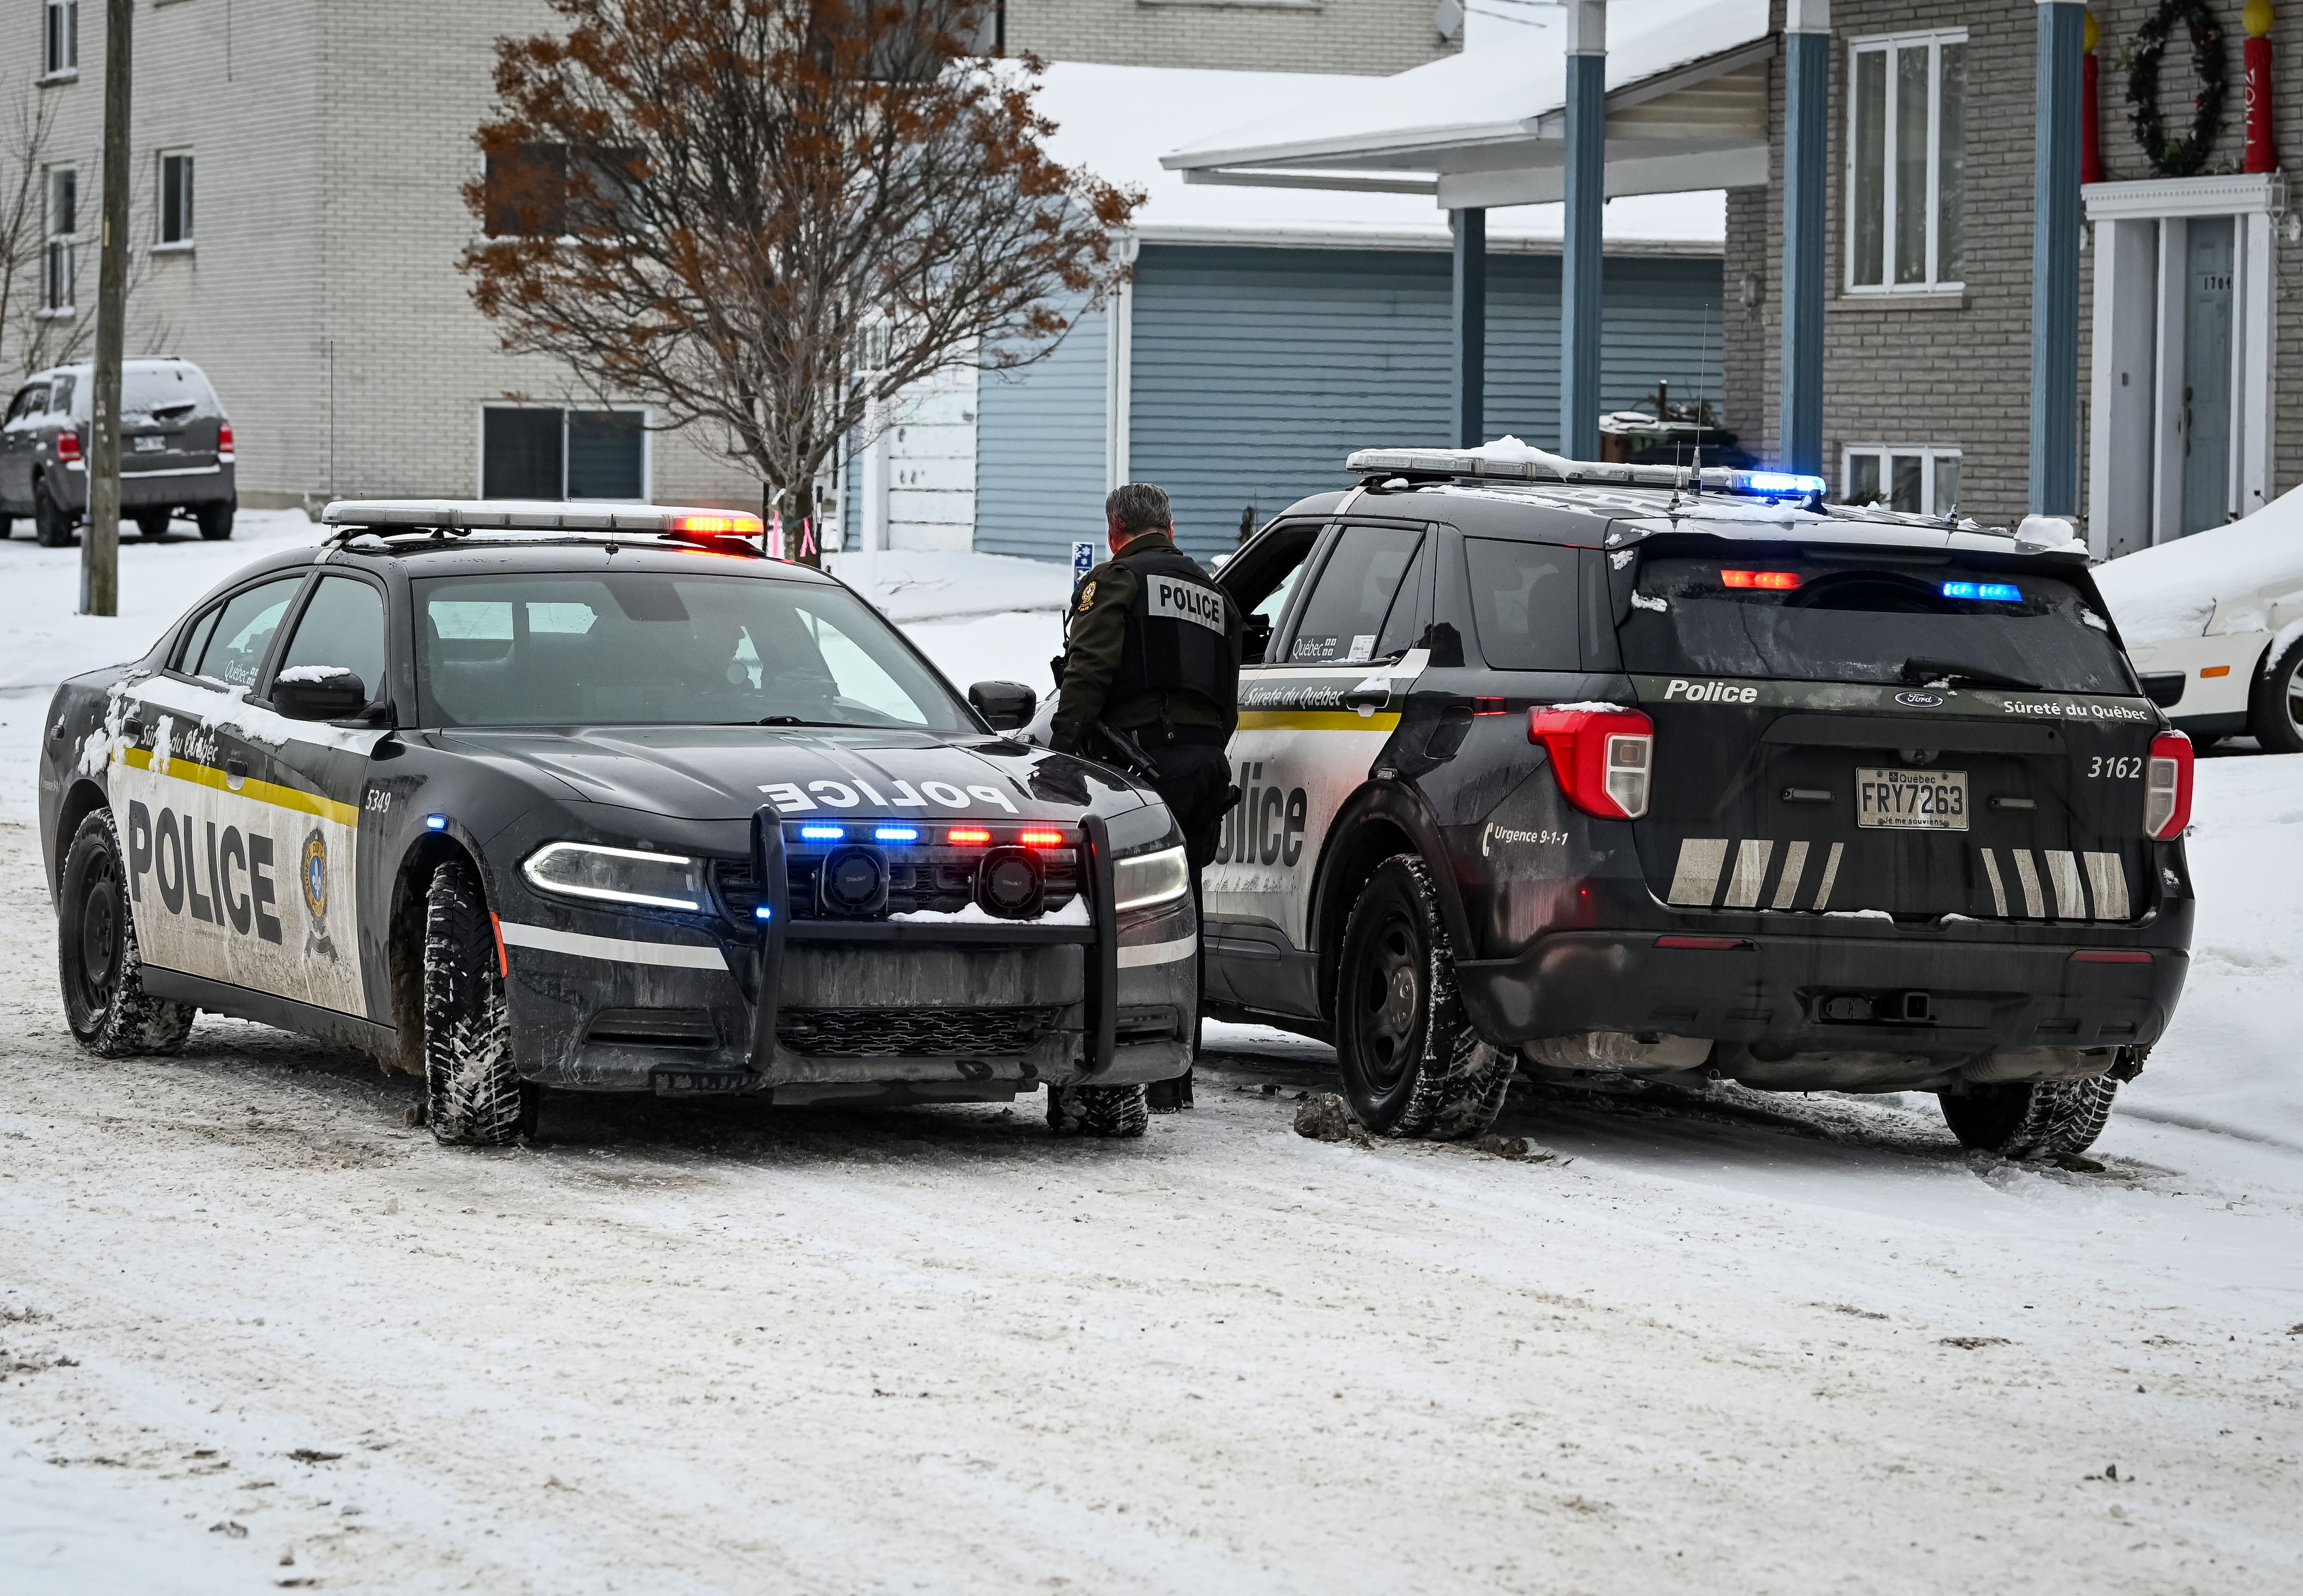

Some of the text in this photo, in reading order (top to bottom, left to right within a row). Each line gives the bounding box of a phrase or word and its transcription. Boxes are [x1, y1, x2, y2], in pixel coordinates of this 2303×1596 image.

[1160, 583, 1219, 624] POLICE
[1292, 638, 1323, 659] Québec
[225, 660, 249, 683] Québec
[1245, 686, 1344, 710] Sûreté du Québec
[1664, 680, 1757, 703] Police
[1907, 693, 1933, 703] Ford
[2004, 701, 2147, 720] Sûreté du Québec
[170, 732, 183, 753] du
[2087, 756, 2142, 778] 3162
[1900, 774, 1935, 783] Québec
[365, 789, 391, 813] 5349
[1862, 782, 1963, 815] FRY7263
[1495, 826, 1568, 845] Urgence 9-1-1
[313, 843, 319, 853] DU
[129, 799, 282, 945] POLICE
